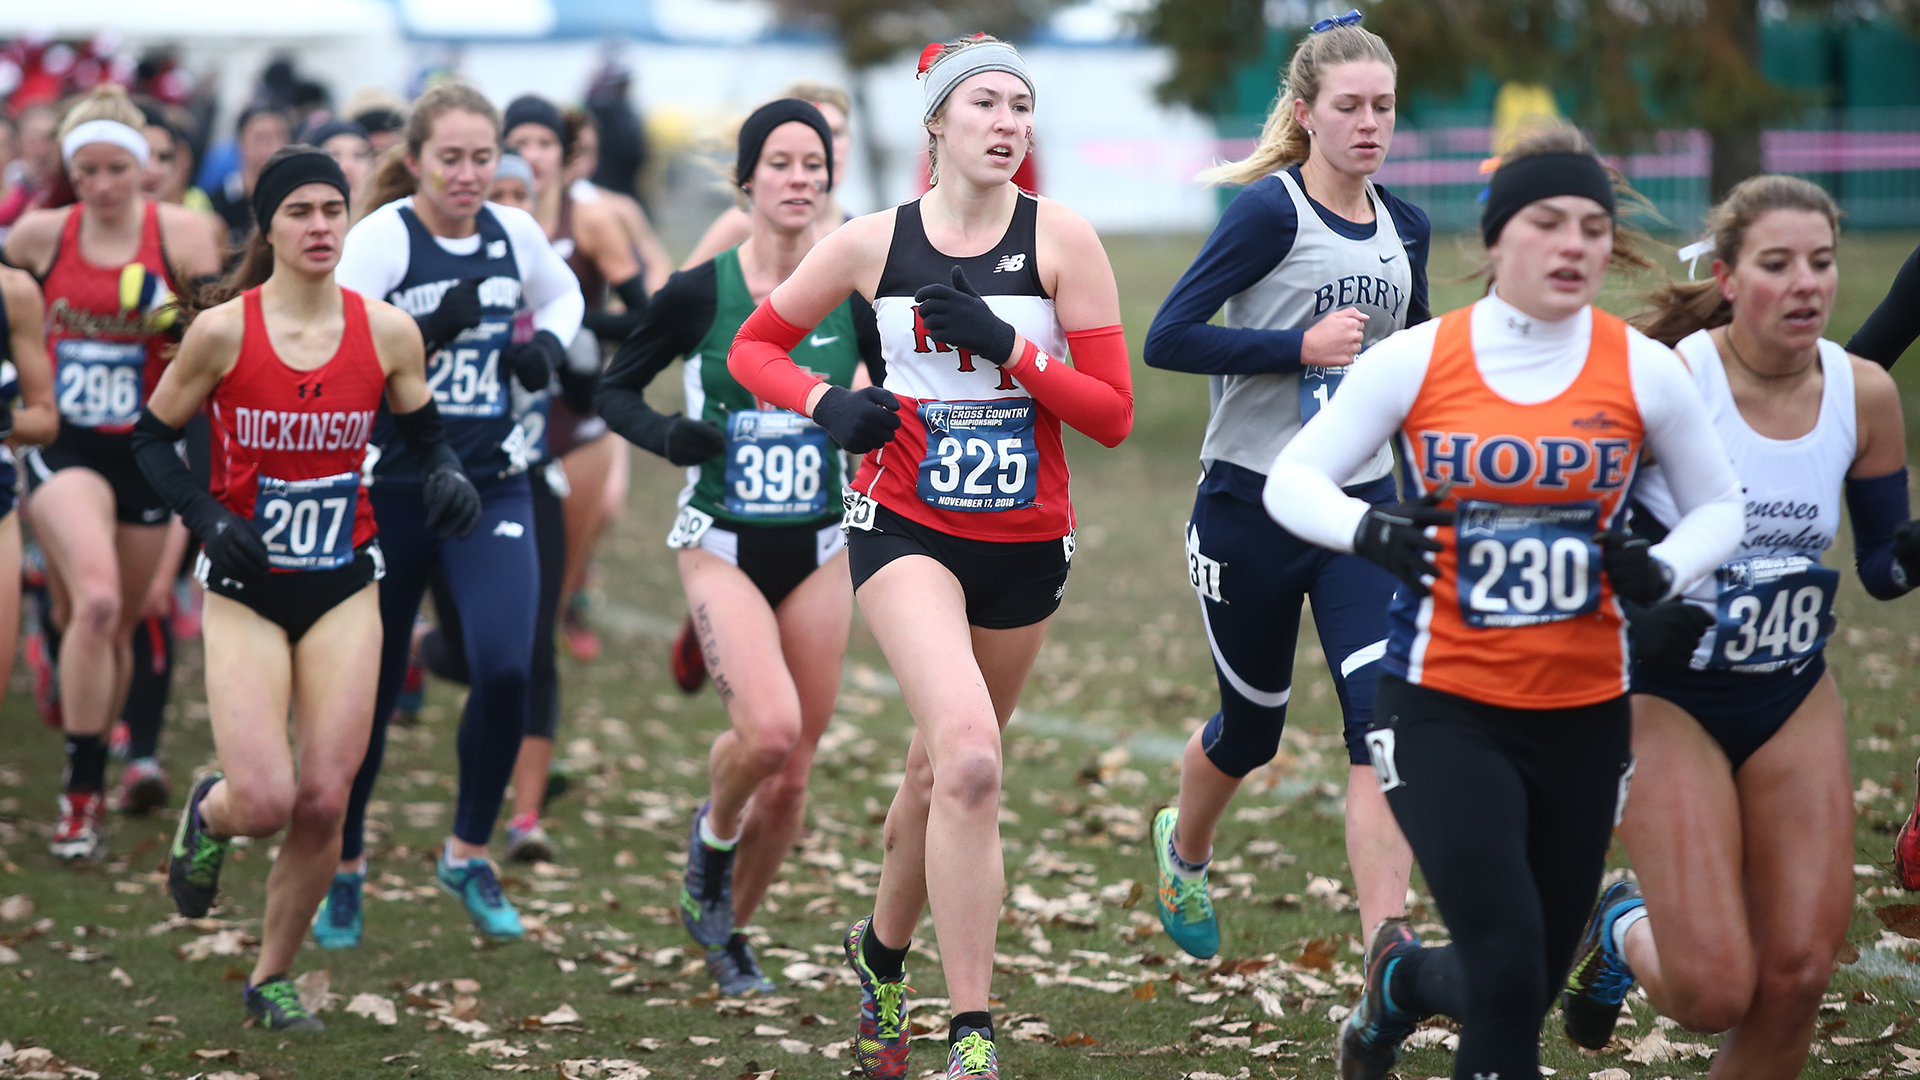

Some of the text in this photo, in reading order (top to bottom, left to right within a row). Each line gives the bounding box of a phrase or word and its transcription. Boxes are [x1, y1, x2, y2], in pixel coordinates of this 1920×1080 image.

[992, 253, 1027, 274] NB
[1312, 275, 1405, 320] BERRY
[59, 362, 138, 417] 296
[426, 348, 500, 404] 254
[235, 406, 376, 450] DICKINSON
[950, 418, 1003, 426] CHAMPIONSHIPS
[951, 407, 1029, 419] CROSS COUNTRY
[735, 444, 822, 502] 398
[930, 437, 1028, 494] 325
[1418, 430, 1631, 492] HOPE
[261, 497, 348, 555] 207
[938, 496, 1015, 508] NOVEMBER 17, 2018
[1743, 492, 1819, 519] eneseo
[1469, 537, 1589, 614] 230
[1724, 586, 1824, 661] 348
